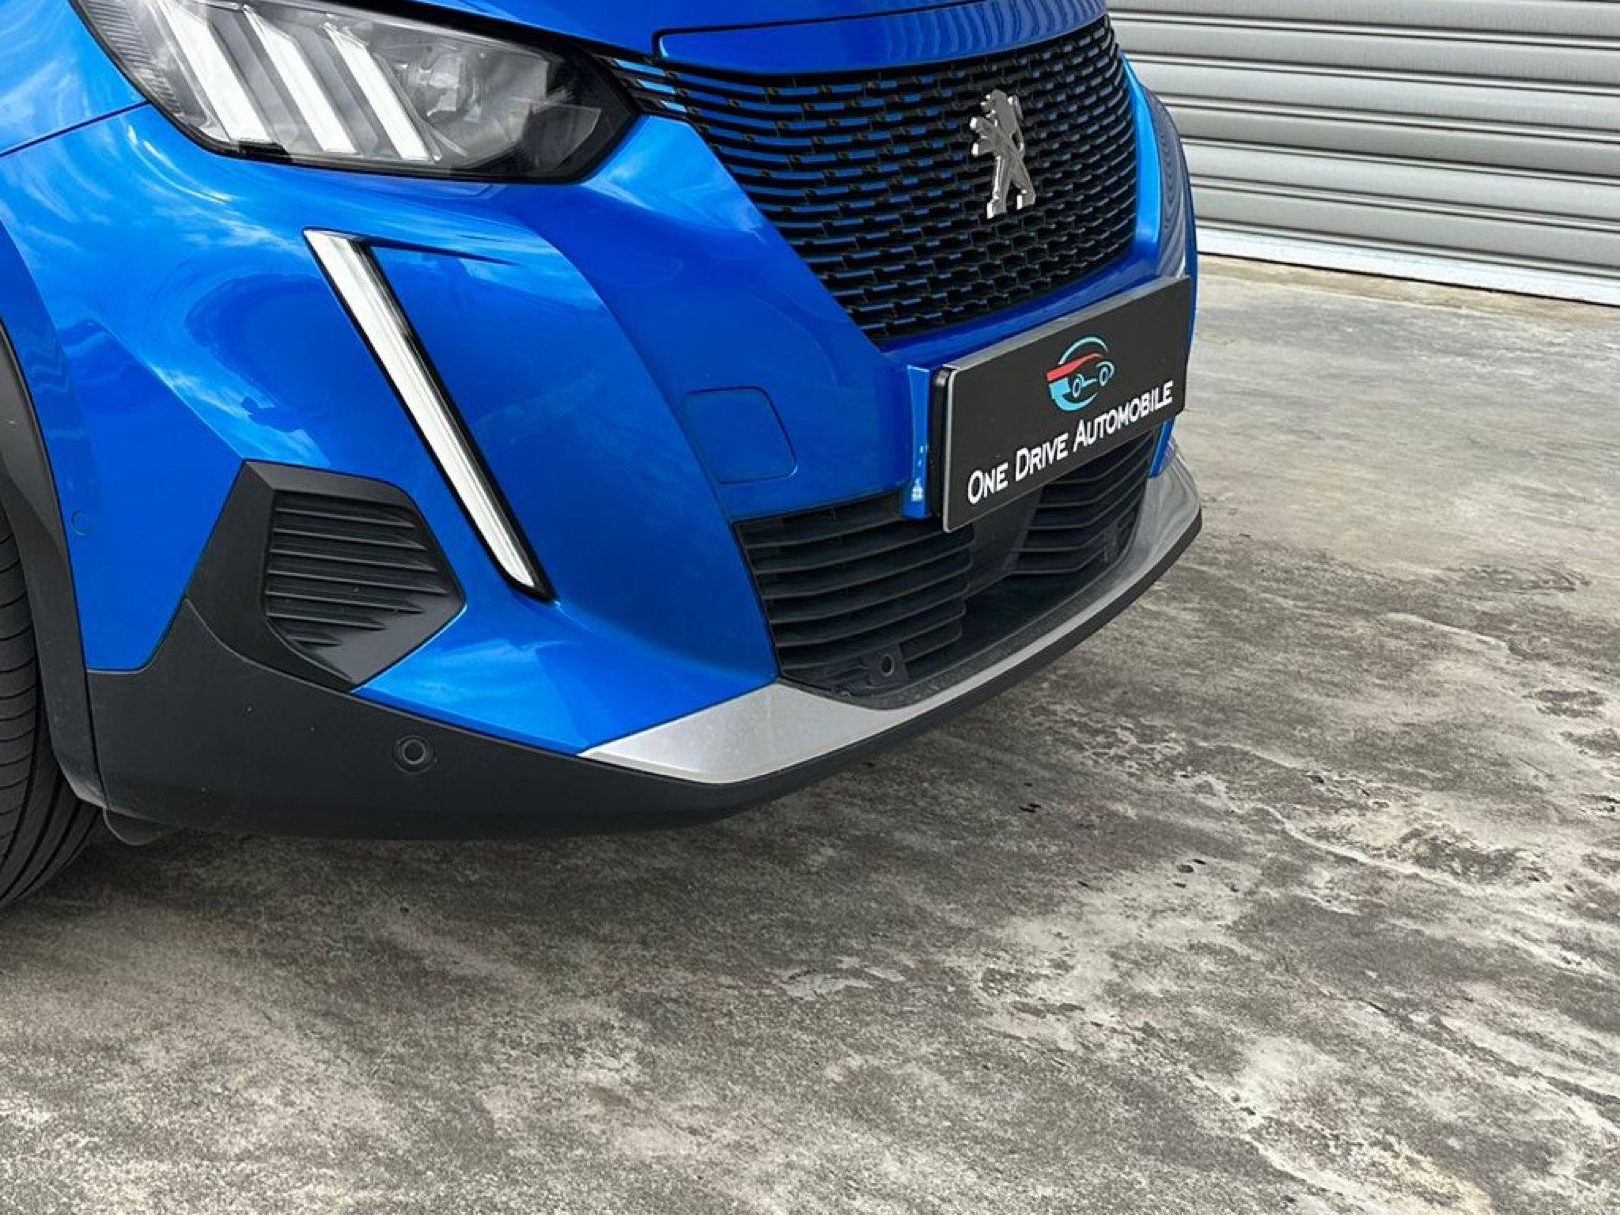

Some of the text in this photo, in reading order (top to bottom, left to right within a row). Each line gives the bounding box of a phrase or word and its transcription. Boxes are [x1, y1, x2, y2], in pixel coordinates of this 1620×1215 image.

[967, 379, 1174, 505] ONE DRIVE AUTOMOBILE
